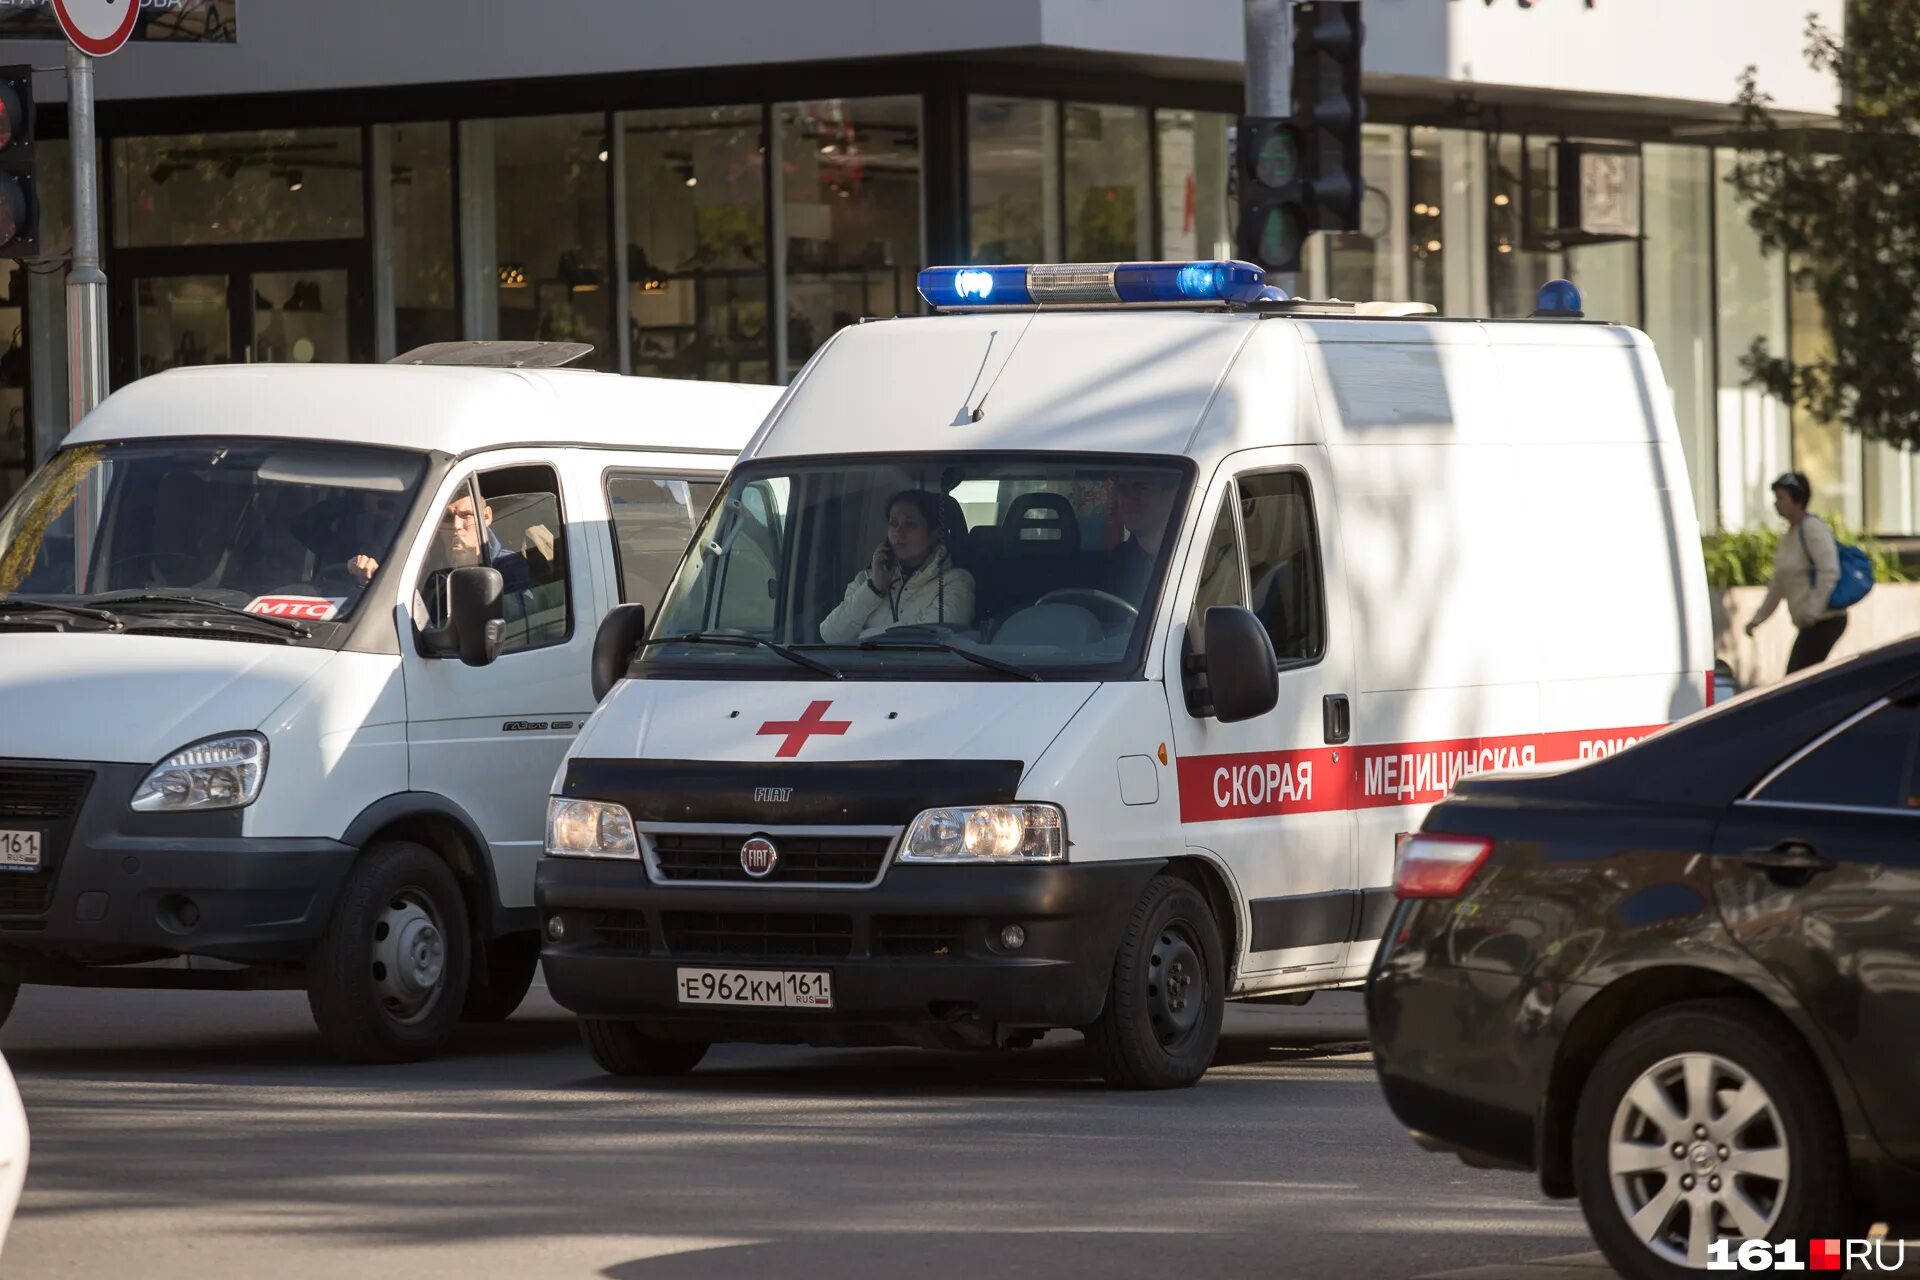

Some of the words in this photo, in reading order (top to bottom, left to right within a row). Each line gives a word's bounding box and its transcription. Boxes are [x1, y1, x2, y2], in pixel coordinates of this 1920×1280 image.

[250, 602, 332, 617] МТС
[1213, 761, 1312, 808] СКОРАЯ
[754, 787, 793, 802] FIAT
[1, 833, 34, 854] 161
[748, 849, 768, 867] FIAT
[686, 973, 782, 1002] Е962КМ
[787, 974, 823, 996] 161
[796, 995, 815, 1004] RUS
